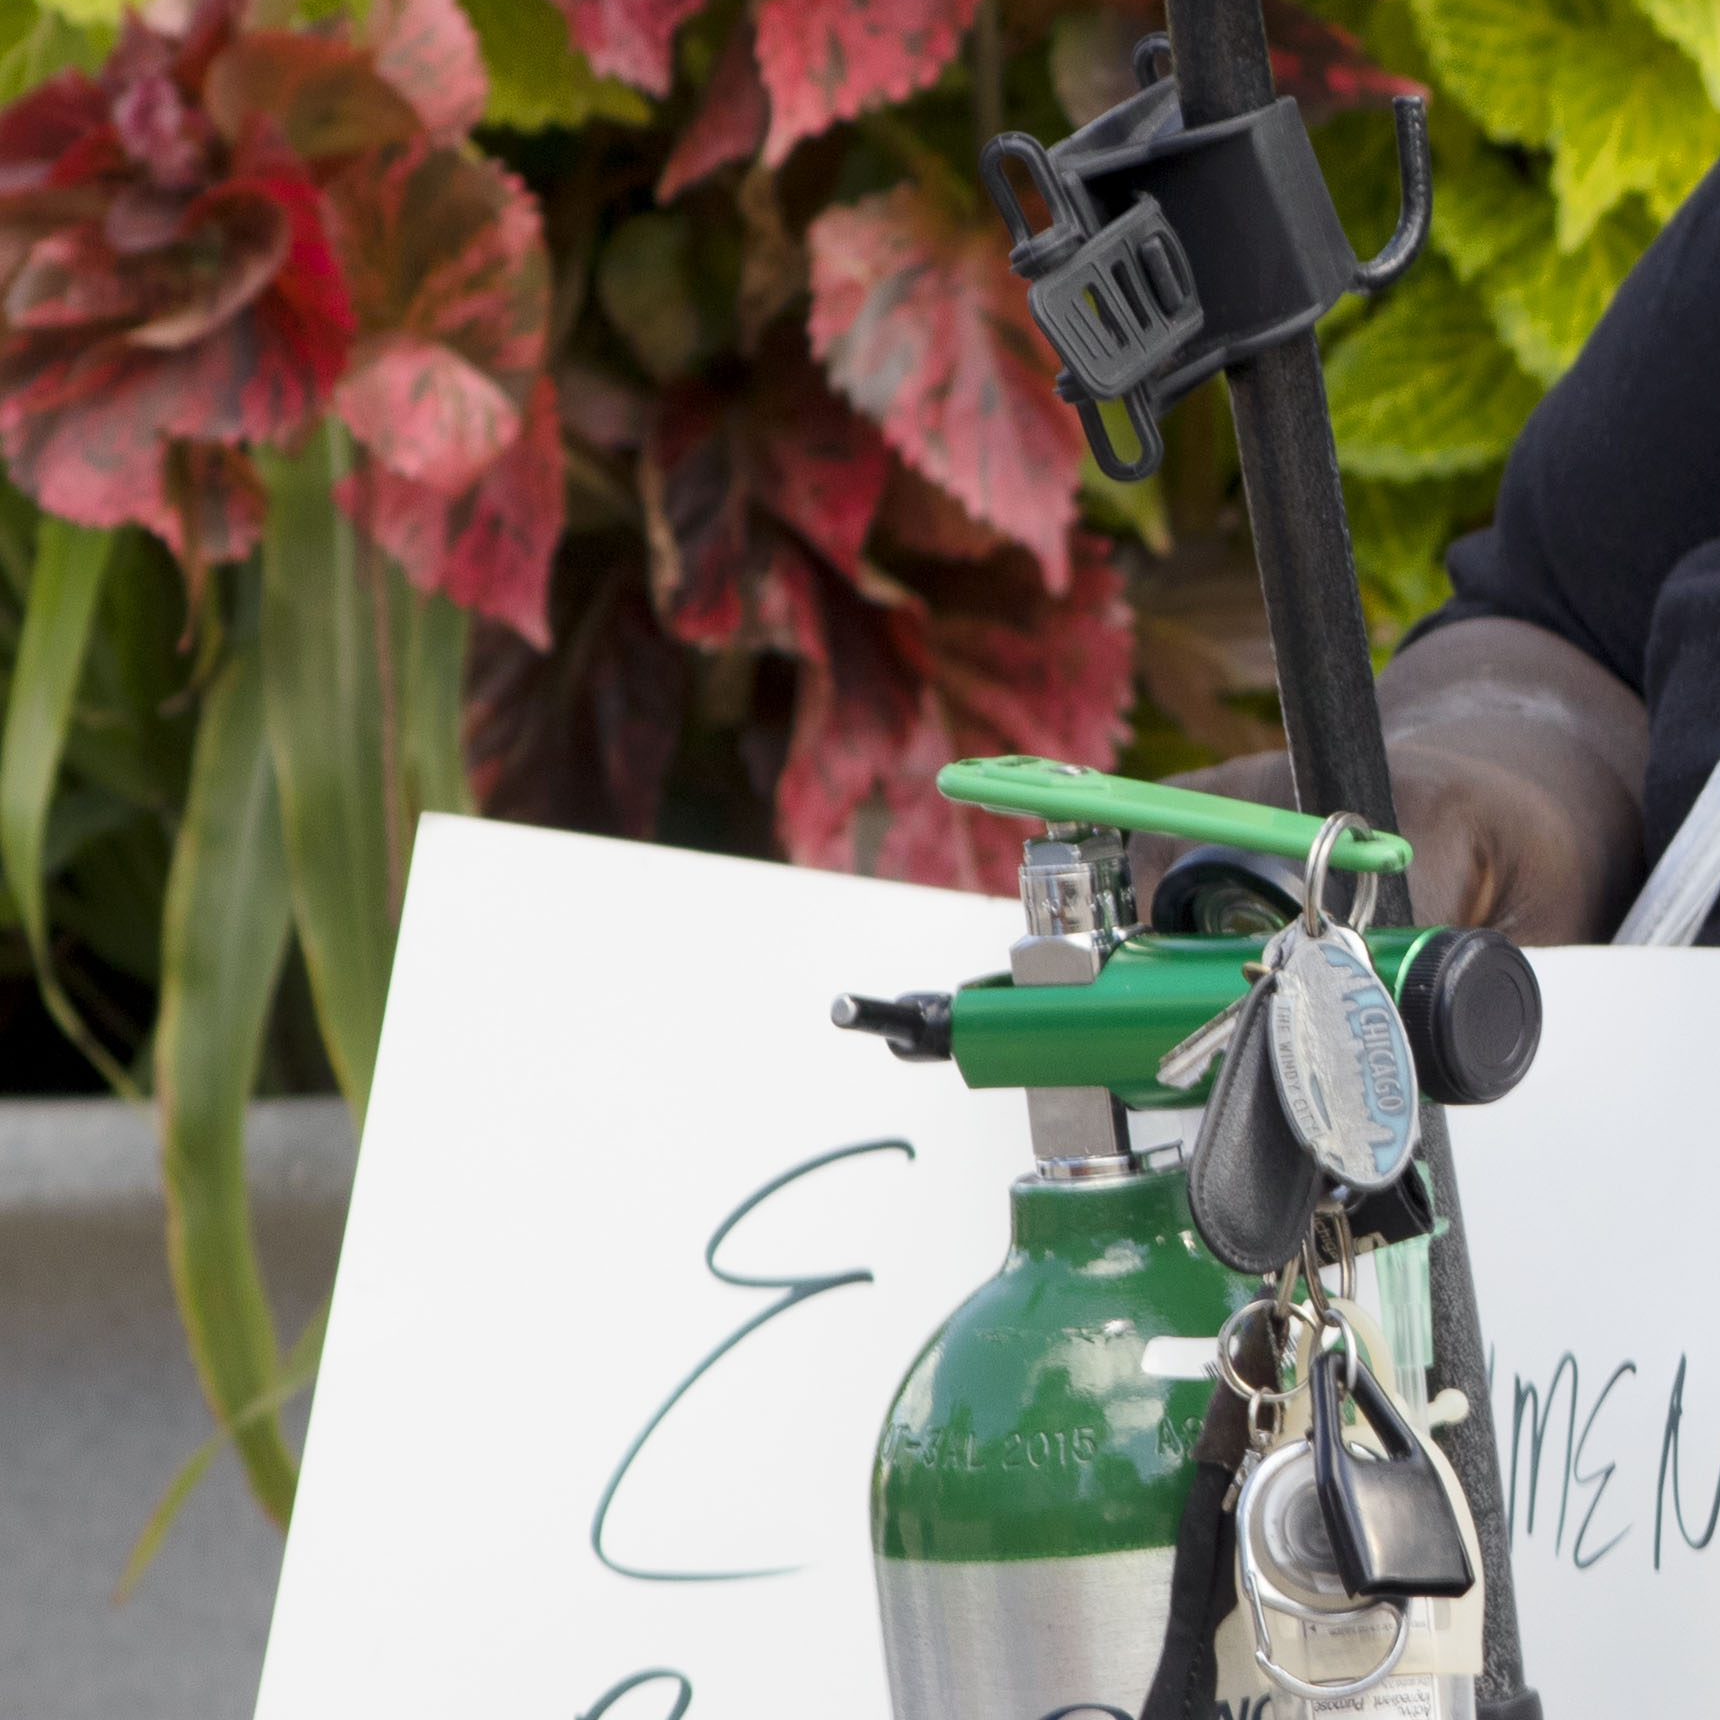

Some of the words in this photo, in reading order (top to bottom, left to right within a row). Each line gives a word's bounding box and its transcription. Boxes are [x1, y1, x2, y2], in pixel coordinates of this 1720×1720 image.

[1276, 1005, 1292, 1032] THE
[1278, 1040, 1301, 1092] WINDY
[1360, 1007, 1404, 1112] CHICAGO
[1292, 1098, 1323, 1139] CITY
